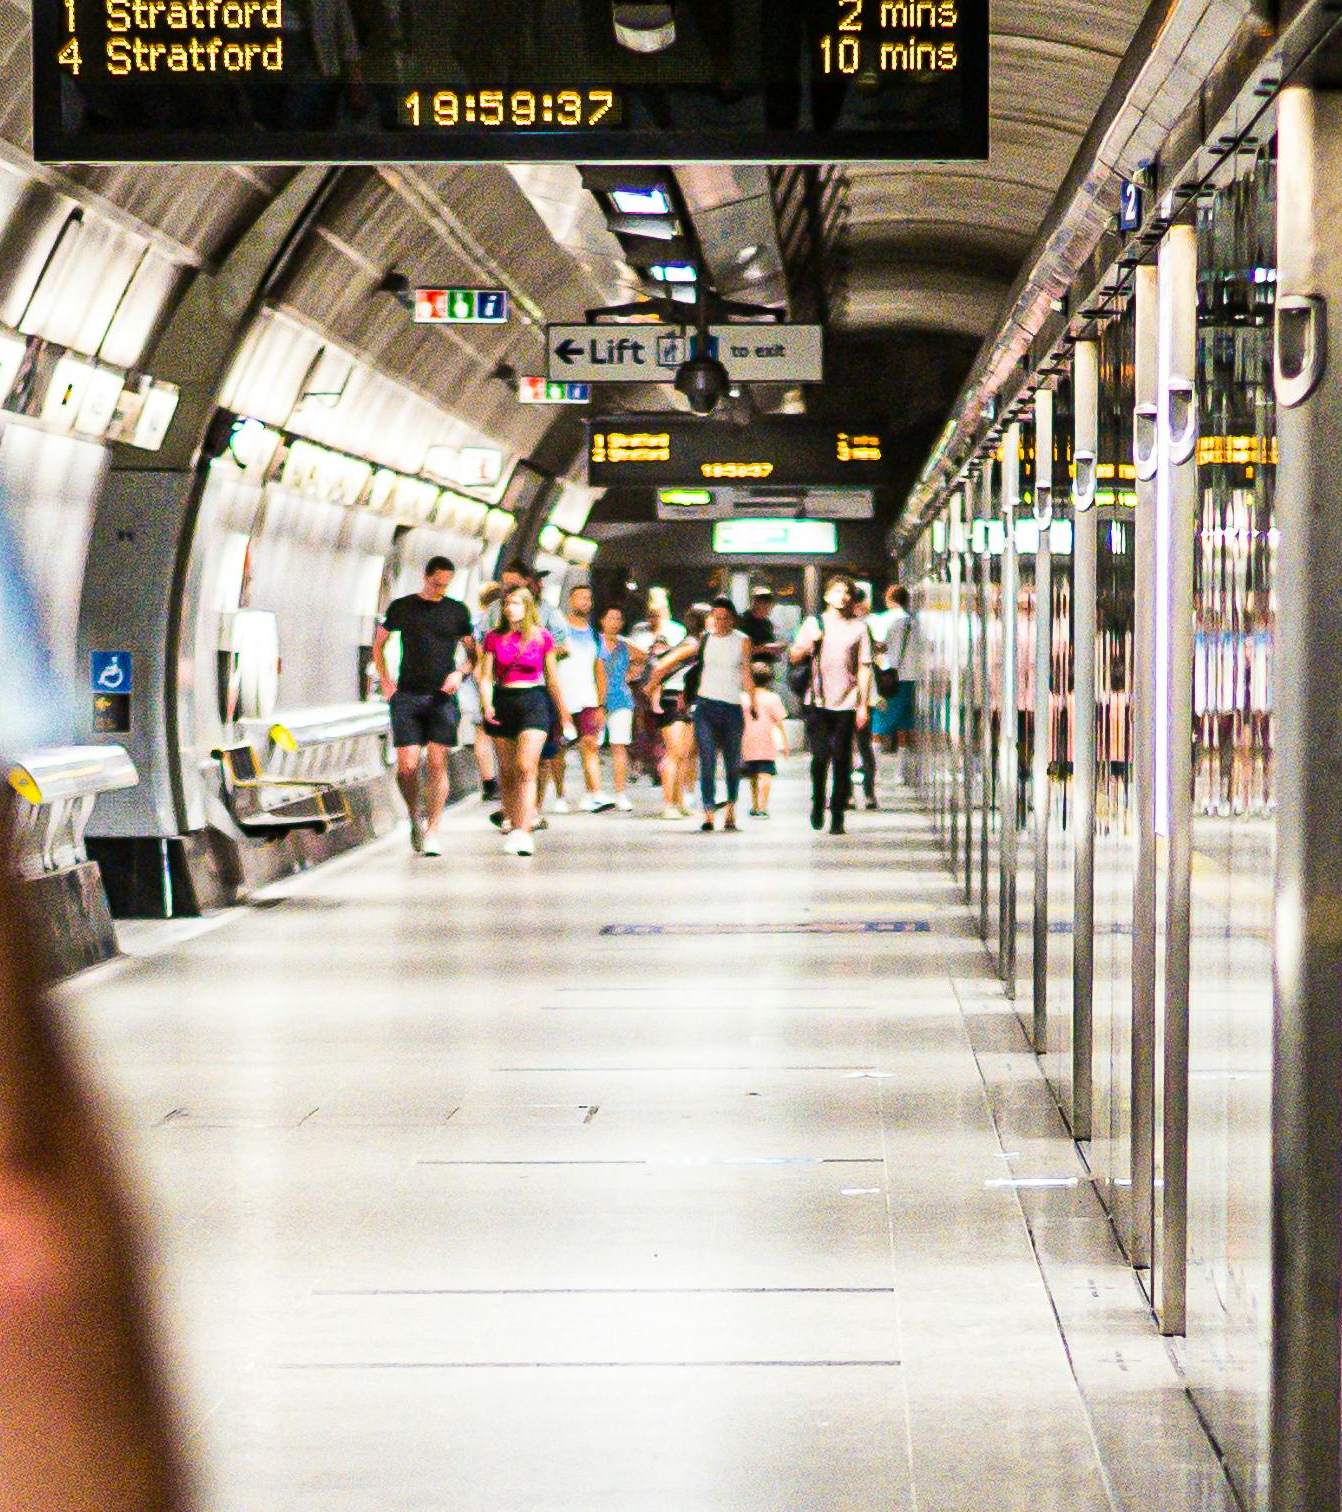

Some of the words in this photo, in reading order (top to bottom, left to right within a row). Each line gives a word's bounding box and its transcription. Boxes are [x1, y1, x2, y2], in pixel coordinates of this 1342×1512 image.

[58, 37, 83, 75] 4
[106, 37, 284, 75] Stratford
[819, 35, 860, 74] 10
[880, 37, 958, 71] mins
[405, 90, 613, 126] 19:59:37
[1125, 183, 1137, 221] 2
[590, 338, 645, 365] Lift
[730, 344, 749, 358] to
[755, 343, 786, 358] exit
